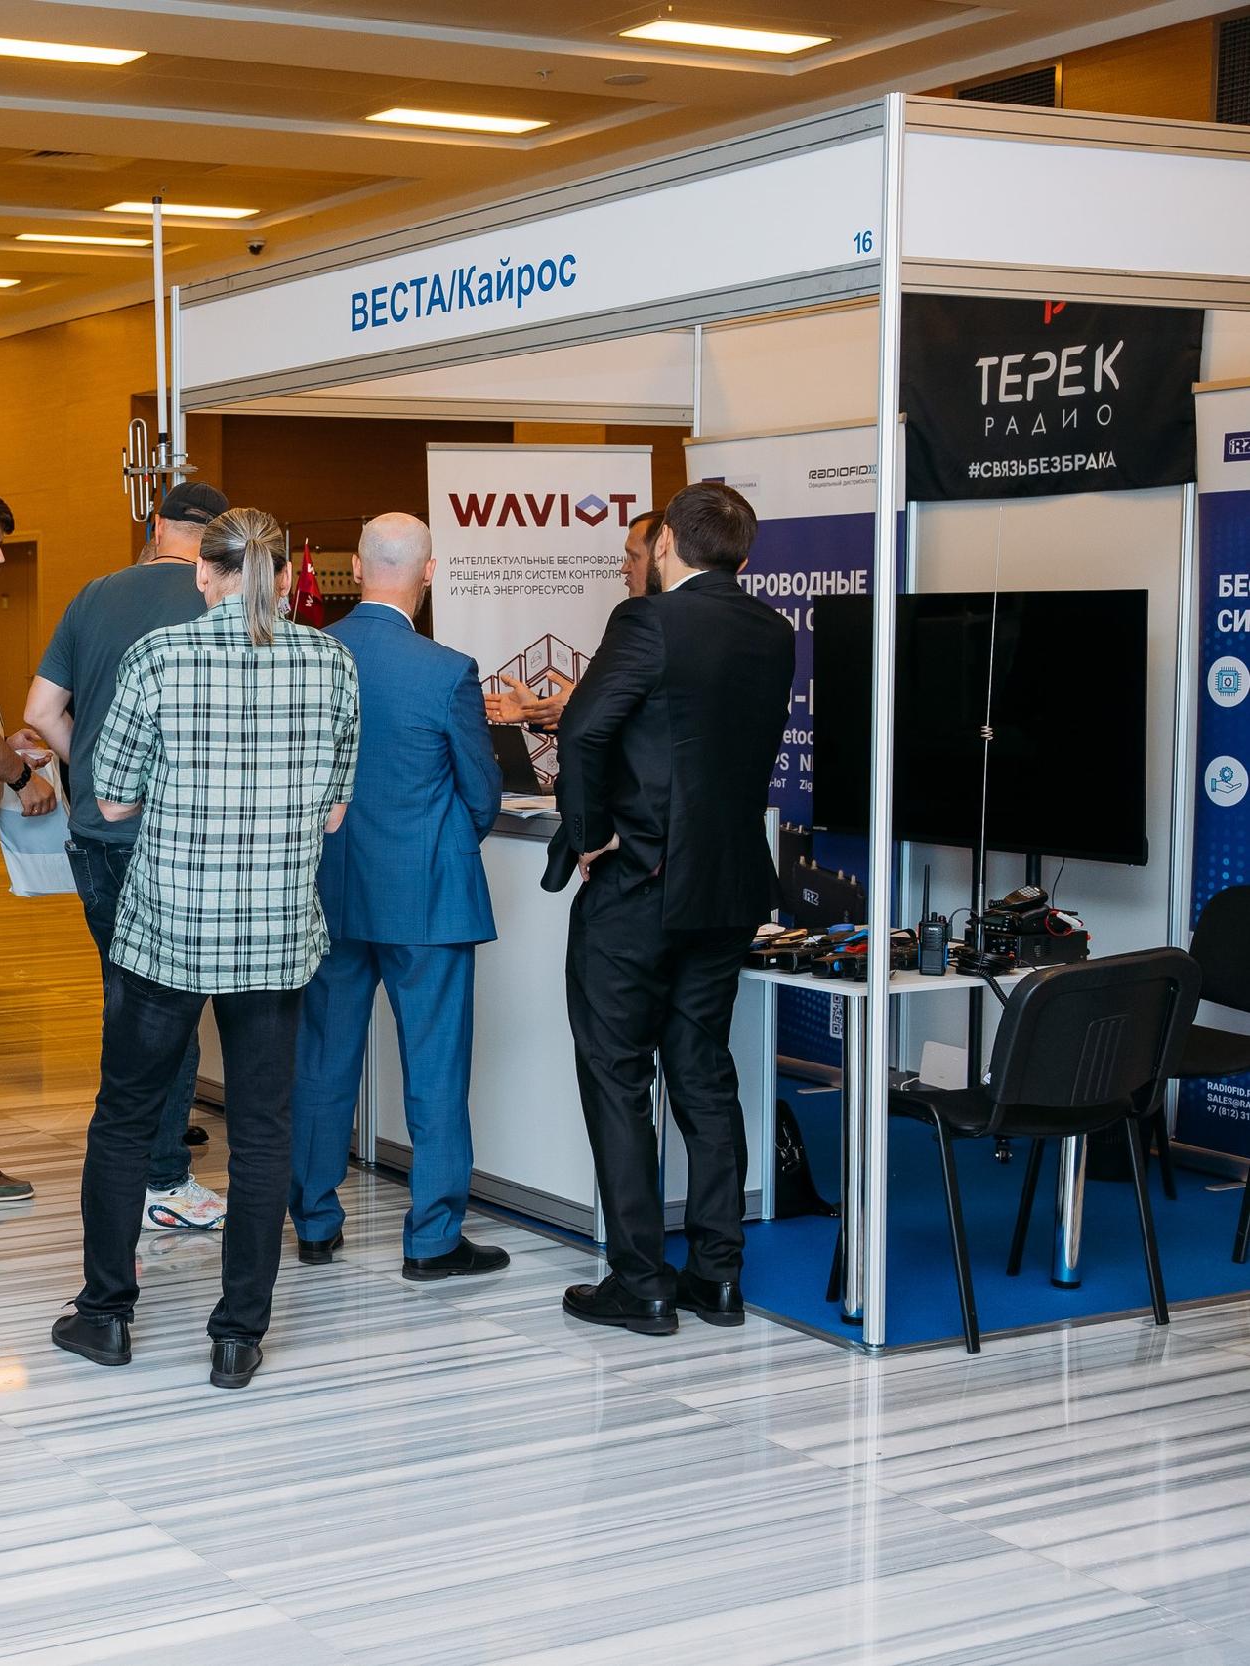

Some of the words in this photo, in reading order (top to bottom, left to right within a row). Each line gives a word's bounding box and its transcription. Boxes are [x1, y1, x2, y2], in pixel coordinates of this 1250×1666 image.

[853, 230, 872, 254] 16
[351, 254, 577, 332] ВЕСТА/Кайрос
[975, 339, 1124, 406] ТЕРЕК
[985, 404, 1112, 437] РАДИО
[968, 450, 1117, 479] #СВЯЗЬБЕЗБРАКА
[448, 493, 637, 528] WAVIOT
[449, 555, 554, 566] ИНТЕЛЛЕКТУАЛЬНЫЕ
[450, 570, 500, 581] РЕШЕНИЯ
[502, 570, 522, 581] ДЛЯ
[524, 569, 567, 580] СИСТЕМ
[569, 569, 622, 580] КОНТРОЛЯ
[1219, 574, 1250, 597] БЕ
[450, 586, 458, 596] И
[460, 584, 491, 596] УЧЁТА
[493, 584, 584, 596] ЭНЕРГОРЕСУРСОВ
[1207, 1104, 1217, 1113] +7
[1219, 1105, 1239, 1120] (812)
